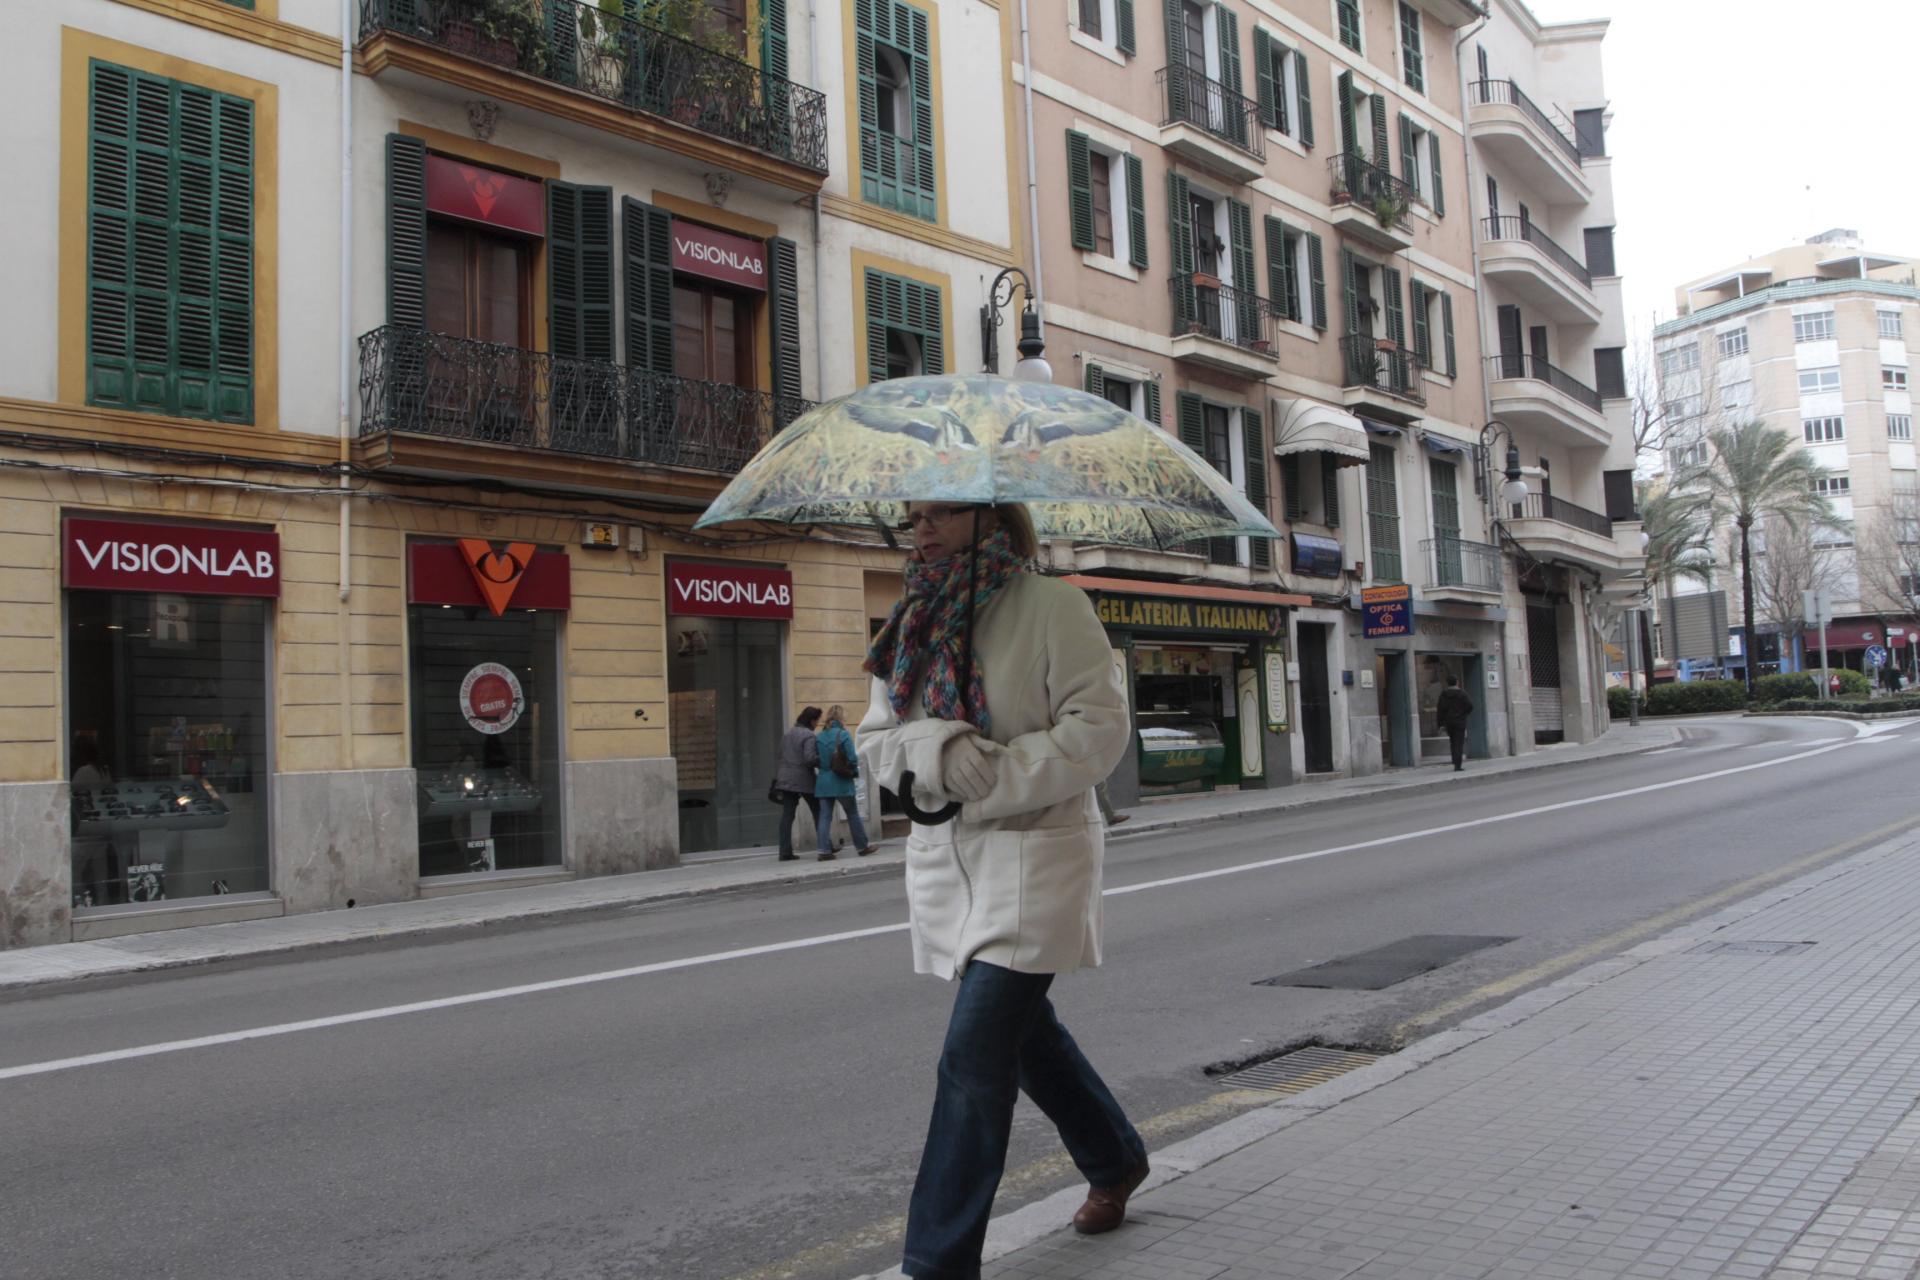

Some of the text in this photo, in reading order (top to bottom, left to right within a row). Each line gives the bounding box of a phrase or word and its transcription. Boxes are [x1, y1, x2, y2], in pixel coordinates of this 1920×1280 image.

[674, 237, 763, 275] VISIONLAB
[75, 539, 274, 579] VISIONLAB
[673, 578, 790, 606] VISIONLAB
[1097, 598, 1269, 632] GELATERIA ITALIANA
[1369, 603, 1403, 614] OPTICA
[480, 699, 506, 713] GRATIS
[128, 864, 149, 874] NEVER
